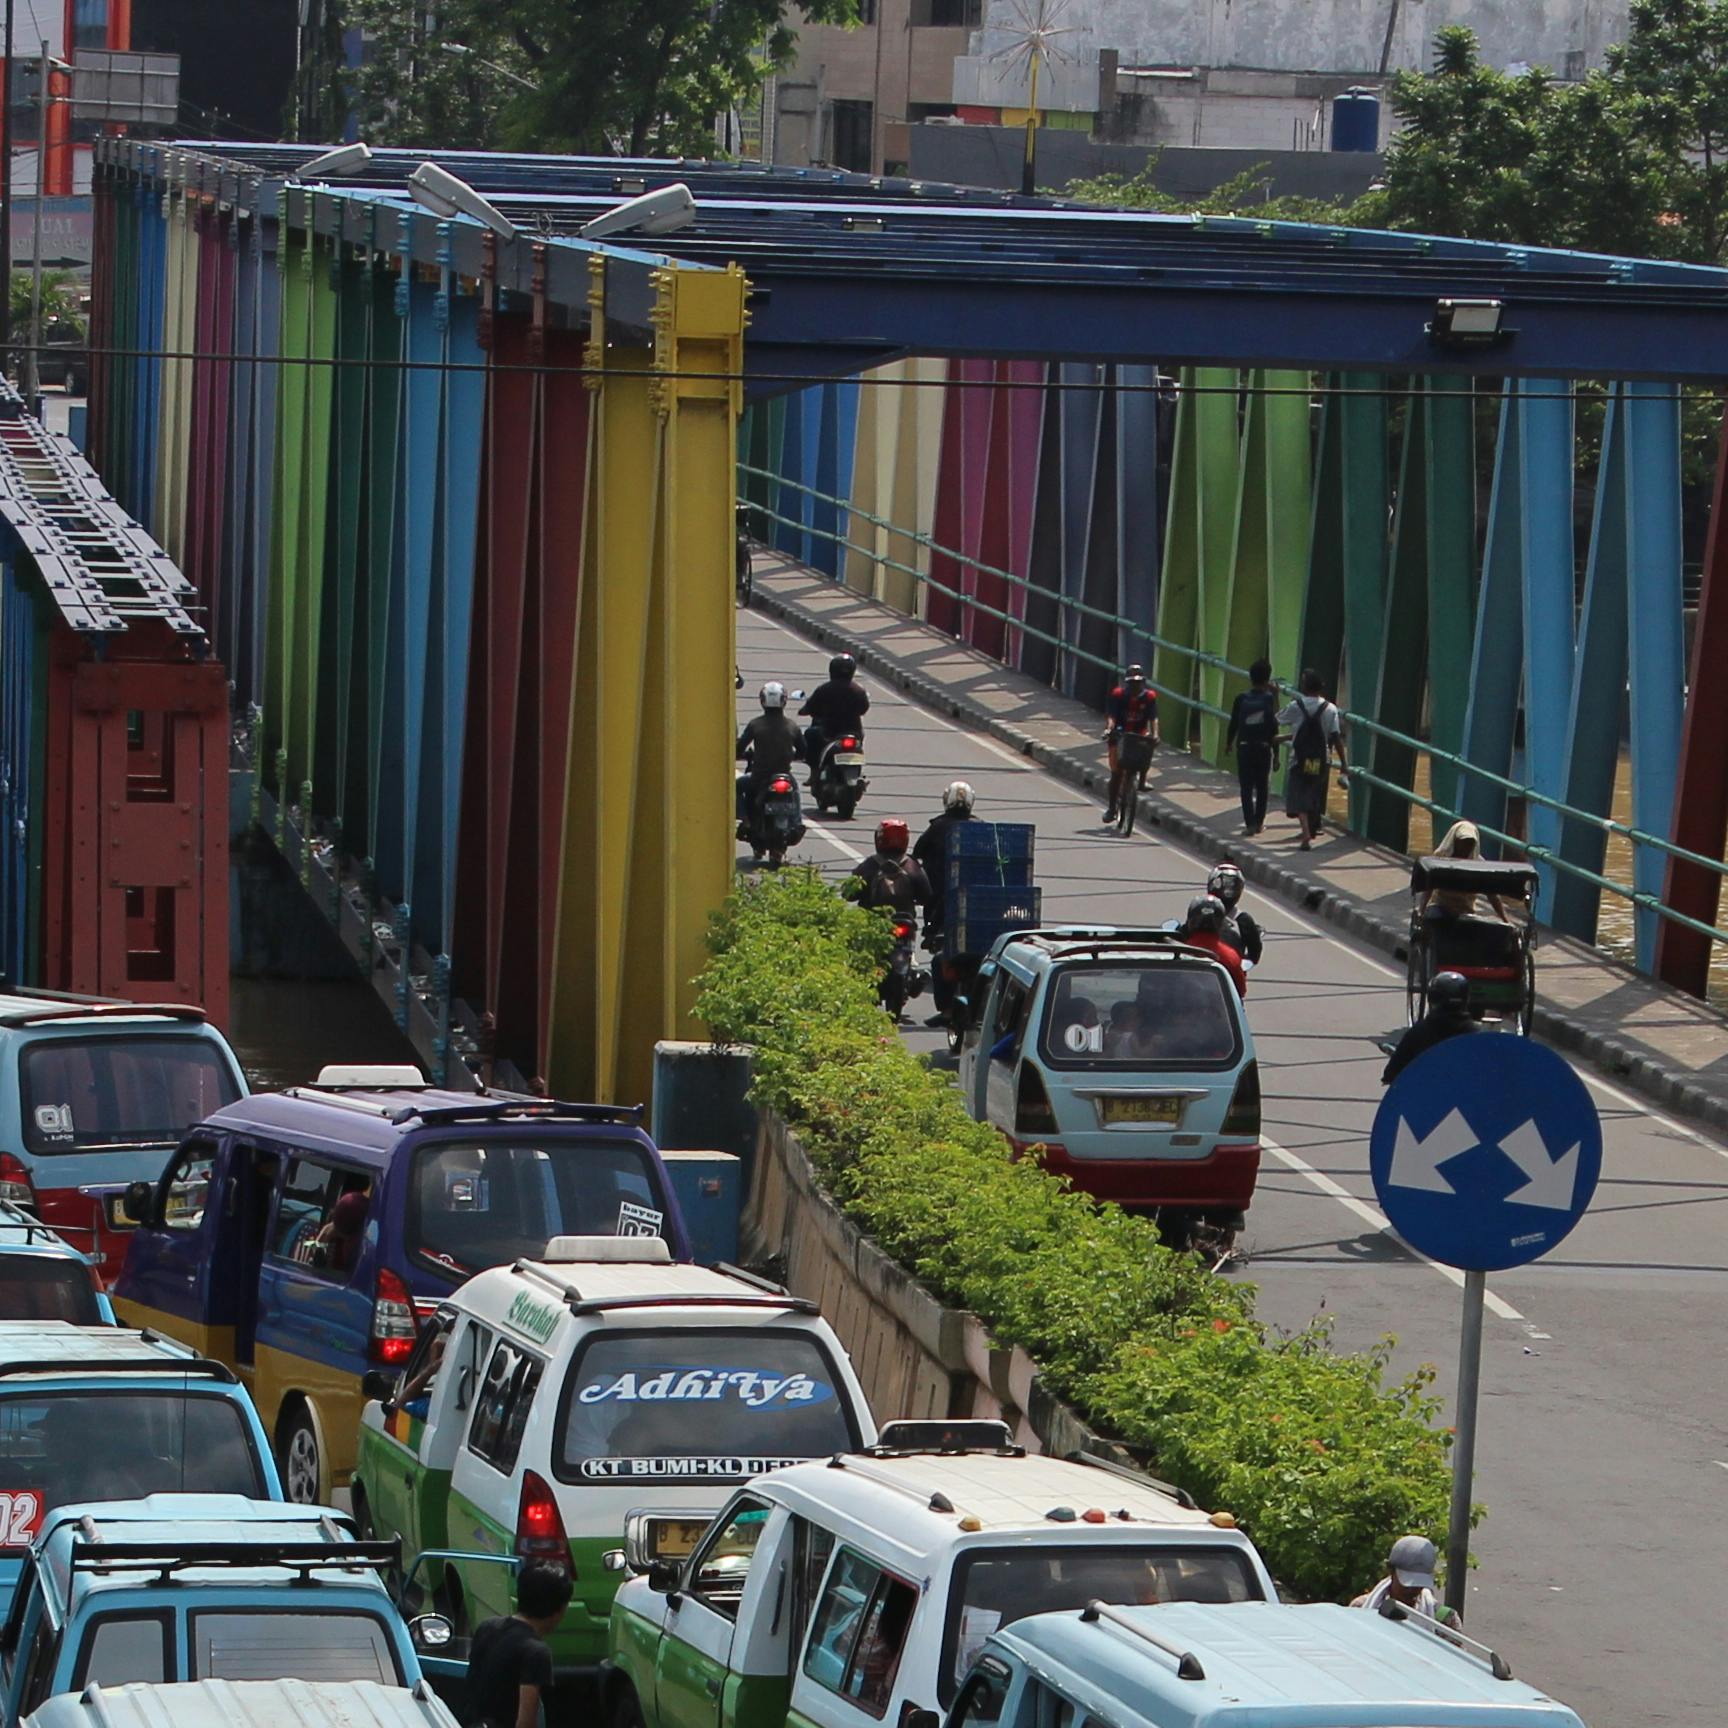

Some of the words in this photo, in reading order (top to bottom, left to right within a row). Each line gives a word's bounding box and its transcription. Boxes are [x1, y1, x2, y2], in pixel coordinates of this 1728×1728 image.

[1064, 1024, 1103, 1052] 01
[35, 1103, 74, 1133] 01
[623, 1204, 660, 1220] bayur
[589, 1459, 622, 1475] KT
